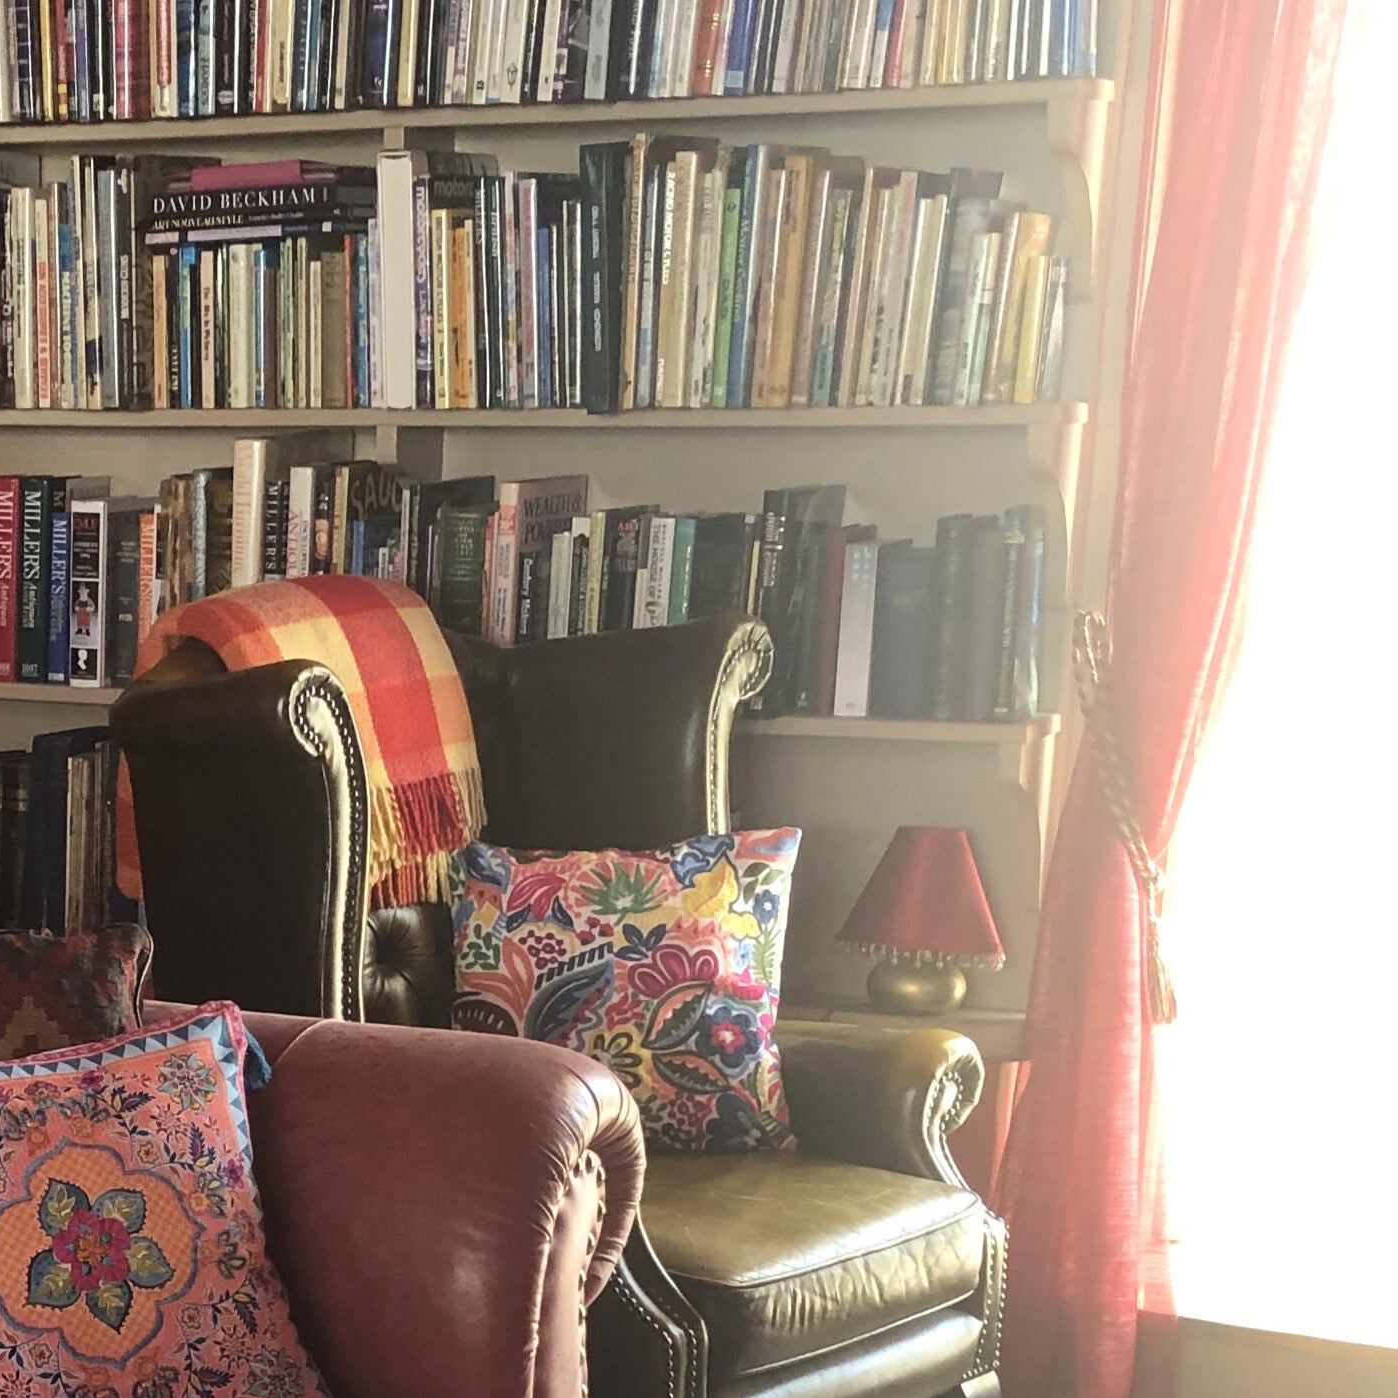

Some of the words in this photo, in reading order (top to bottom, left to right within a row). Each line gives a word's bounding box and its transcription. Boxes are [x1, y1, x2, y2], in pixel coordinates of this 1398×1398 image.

[153, 195, 212, 213] DAVID
[220, 187, 315, 209] BECKHAM
[665, 172, 676, 211] RACING
[664, 212, 674, 249] MOTOR
[350, 468, 402, 520] SAUC
[23, 491, 40, 580] MILLER'S
[265, 484, 281, 570] MILLER'S
[288, 510, 299, 579] ANTIQU
[51, 518, 67, 595] MILLER'S
[141, 522, 154, 596] MILLER'S
[0, 582, 9, 627] Antiques
[28, 582, 37, 628] Antiques
